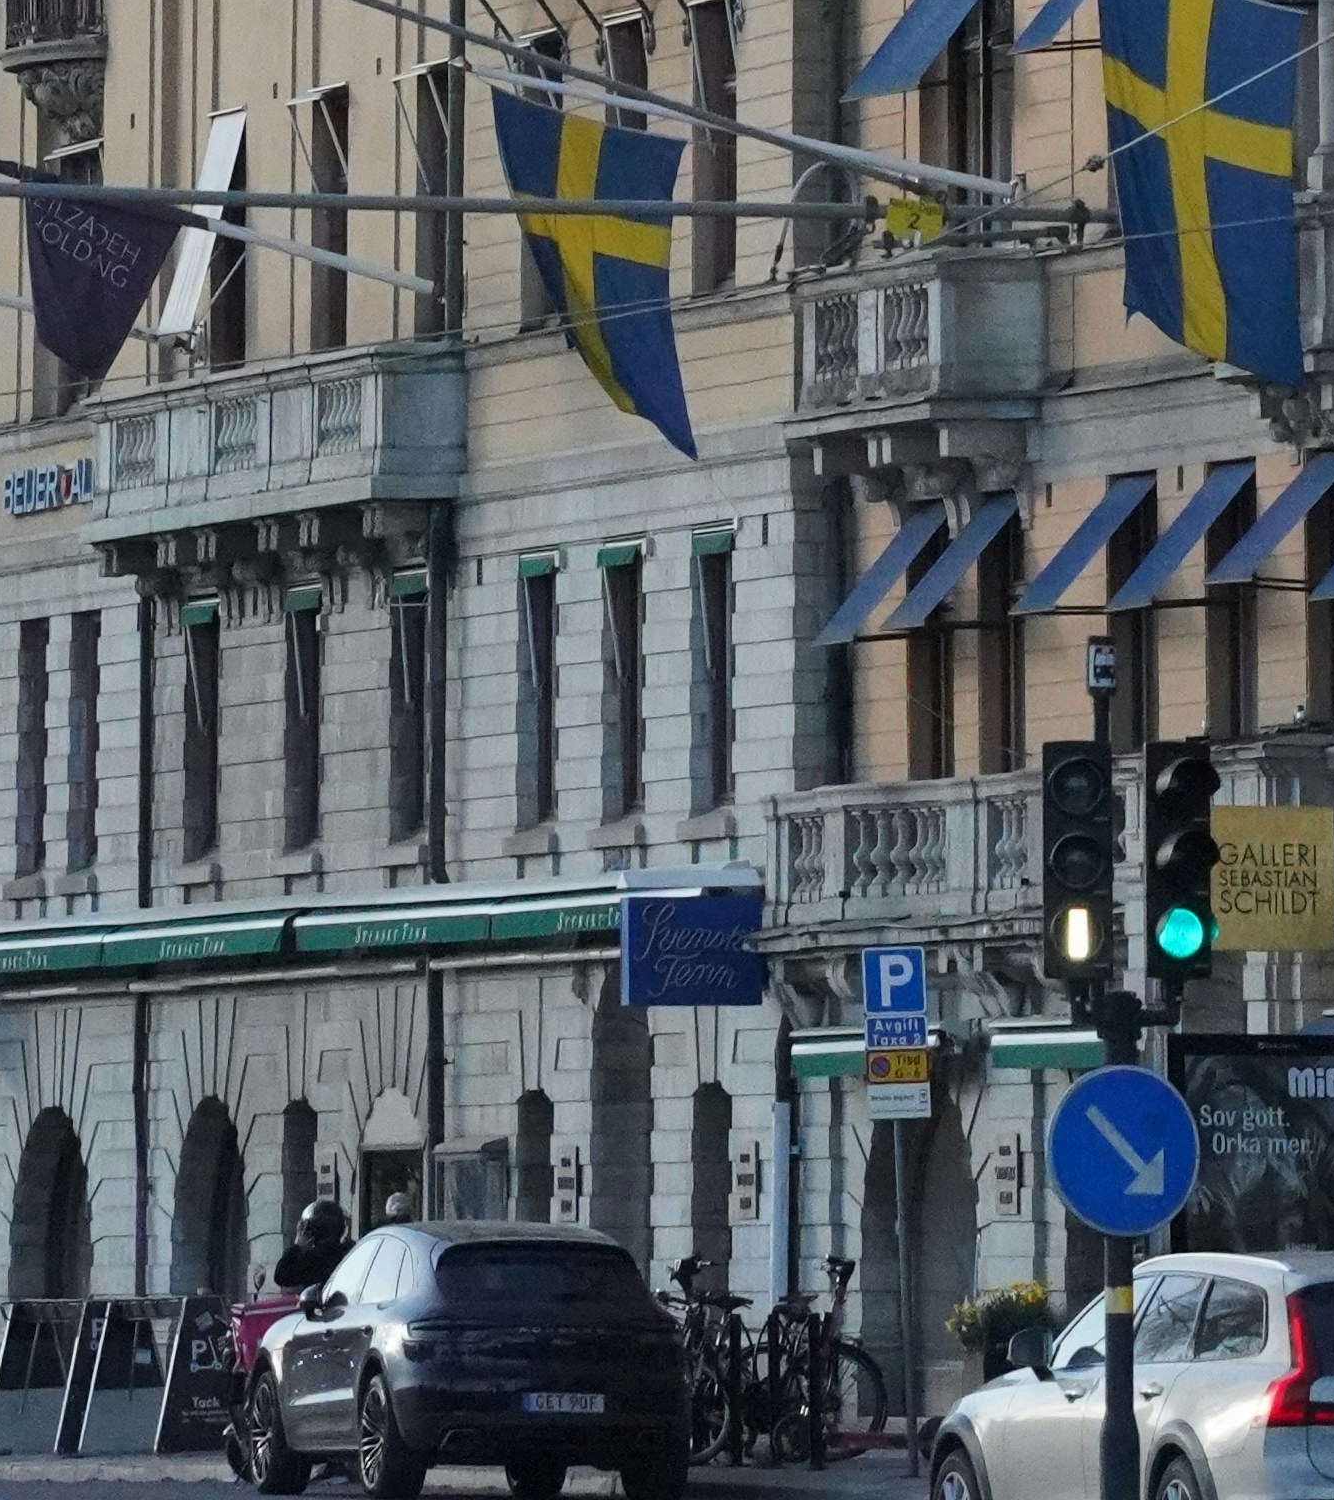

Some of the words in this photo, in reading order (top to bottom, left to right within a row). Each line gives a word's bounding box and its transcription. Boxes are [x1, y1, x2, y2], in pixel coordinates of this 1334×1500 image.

[908, 212, 920, 230] 2
[71, 457, 95, 504] AL
[1219, 842, 1317, 867] GALLERI
[1219, 869, 1317, 888] SEBASTIAN
[1219, 889, 1320, 916] SCHILDT
[634, 902, 744, 961] Svensk
[647, 952, 740, 997] Tenn
[879, 954, 913, 1007] P
[874, 1017, 919, 1035] Avgift
[872, 1034, 907, 1046] Taxa
[913, 1033, 921, 1046] 2
[1199, 1105, 1236, 1127] Sov
[1242, 1106, 1291, 1132] gott.
[1212, 1133, 1261, 1155] Orka
[1268, 1135, 1314, 1156] mer.
[192, 1396, 220, 1407] Tack
